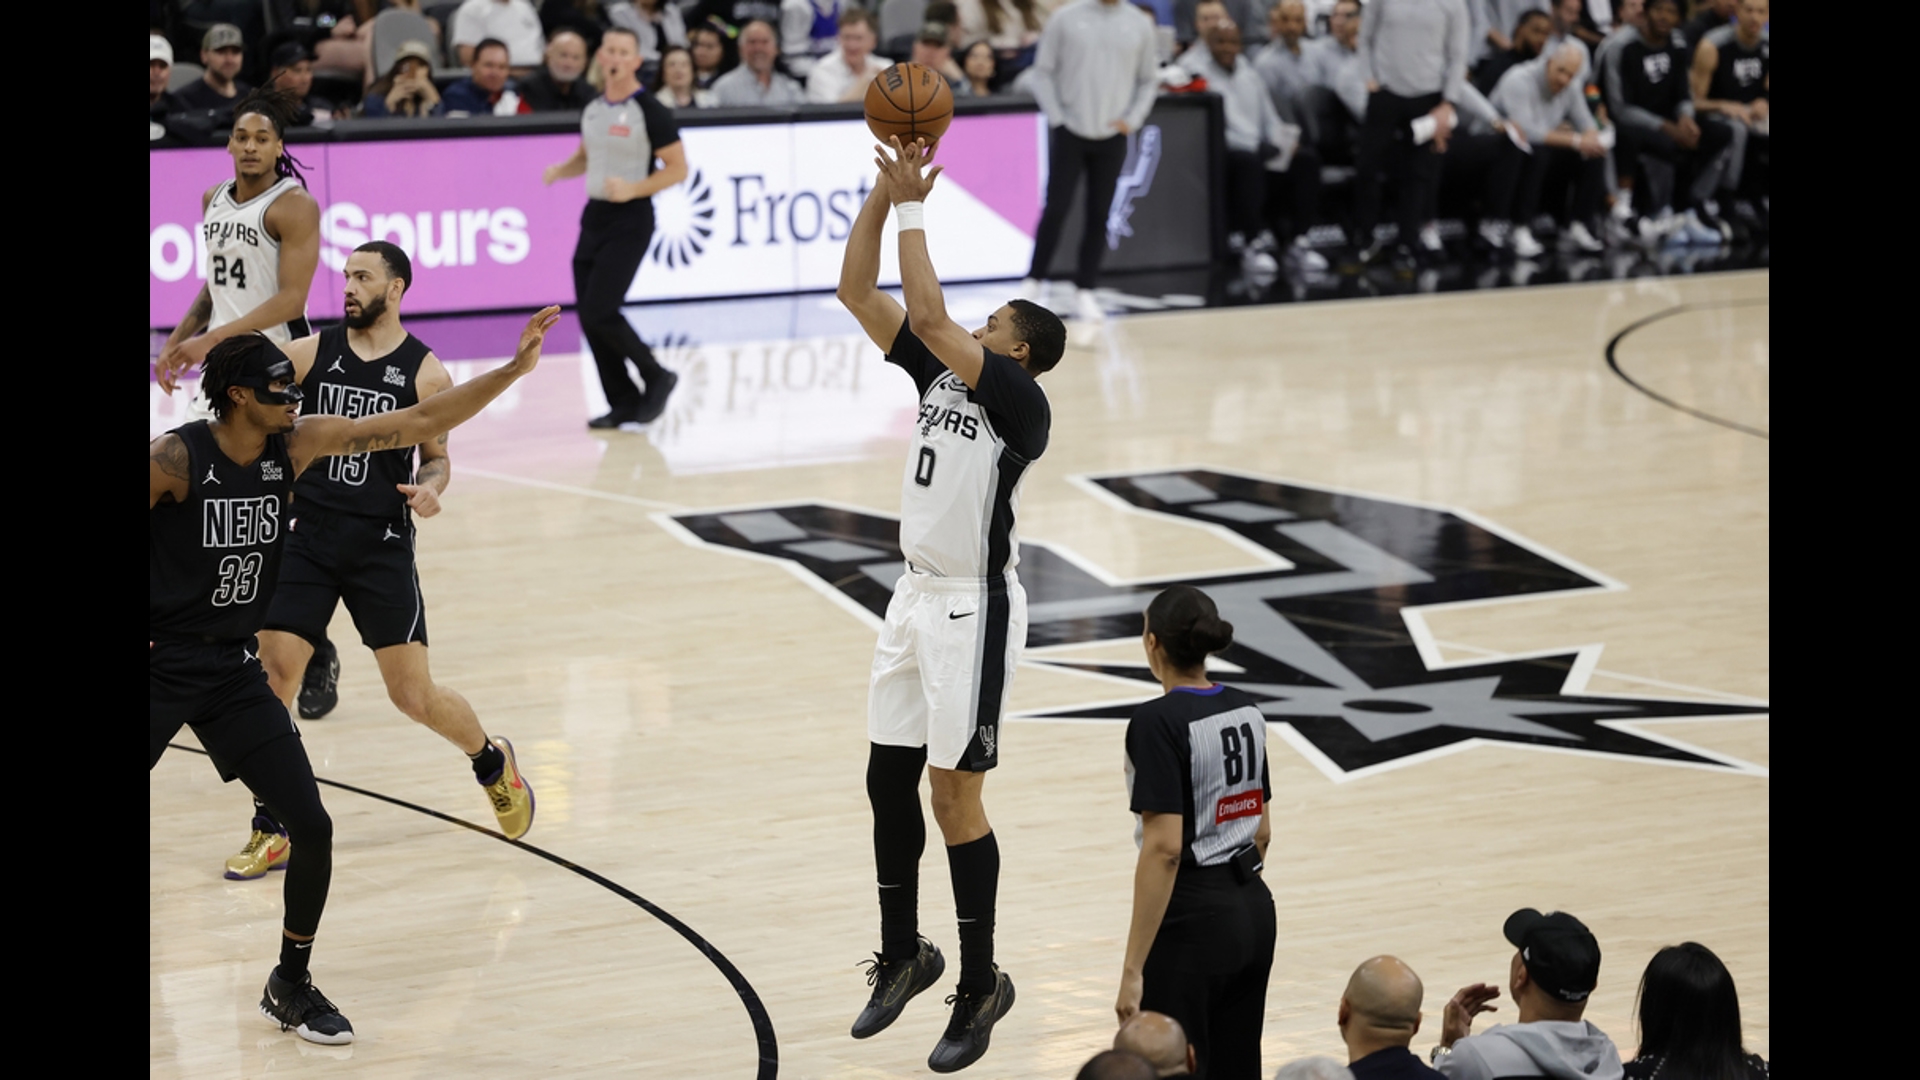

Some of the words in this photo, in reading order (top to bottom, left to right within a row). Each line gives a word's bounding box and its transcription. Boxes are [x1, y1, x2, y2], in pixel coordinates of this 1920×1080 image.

[203, 221, 259, 248] SPURS
[319, 202, 530, 273] Spurs
[213, 255, 247, 289] 24
[318, 382, 397, 418] NETS
[260, 460, 275, 468] GET
[262, 467, 283, 475] YOUR
[329, 451, 371, 486] 13
[915, 446, 936, 487] 0
[203, 495, 280, 547] NETS
[211, 552, 263, 607] 33
[1220, 722, 1257, 787] 81
[1218, 798, 1258, 817] Emirates
